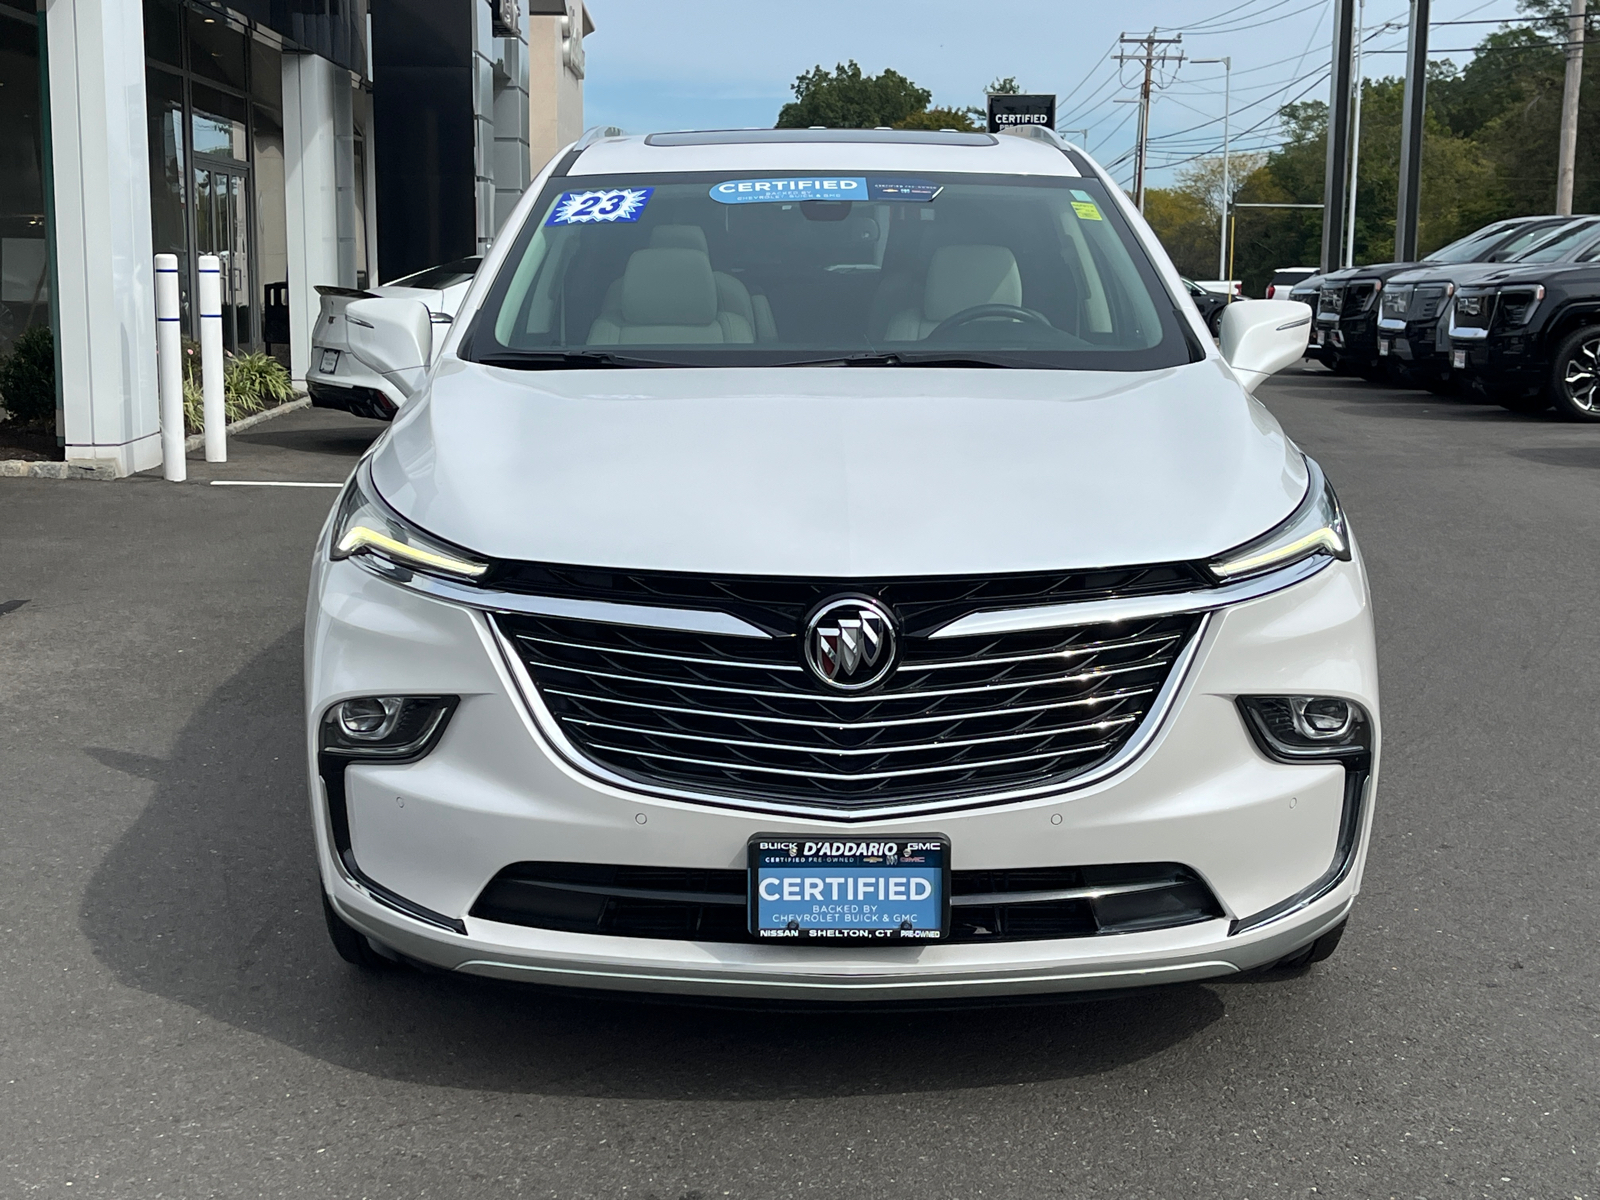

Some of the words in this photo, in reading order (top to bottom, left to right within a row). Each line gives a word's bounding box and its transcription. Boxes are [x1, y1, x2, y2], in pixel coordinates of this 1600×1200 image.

[996, 114, 1048, 124] CERTIFIED
[718, 180, 858, 193] CERTIFIED
[570, 194, 626, 216] 23
[804, 842, 898, 856] D'ADDARIO
[759, 877, 932, 900] CERTIFIED
[812, 905, 858, 913] BACKED
[772, 914, 840, 922] CHEVROLET
[844, 914, 878, 922] BUICK
[893, 914, 918, 922] GMC
[808, 930, 872, 938] SHELTON,
